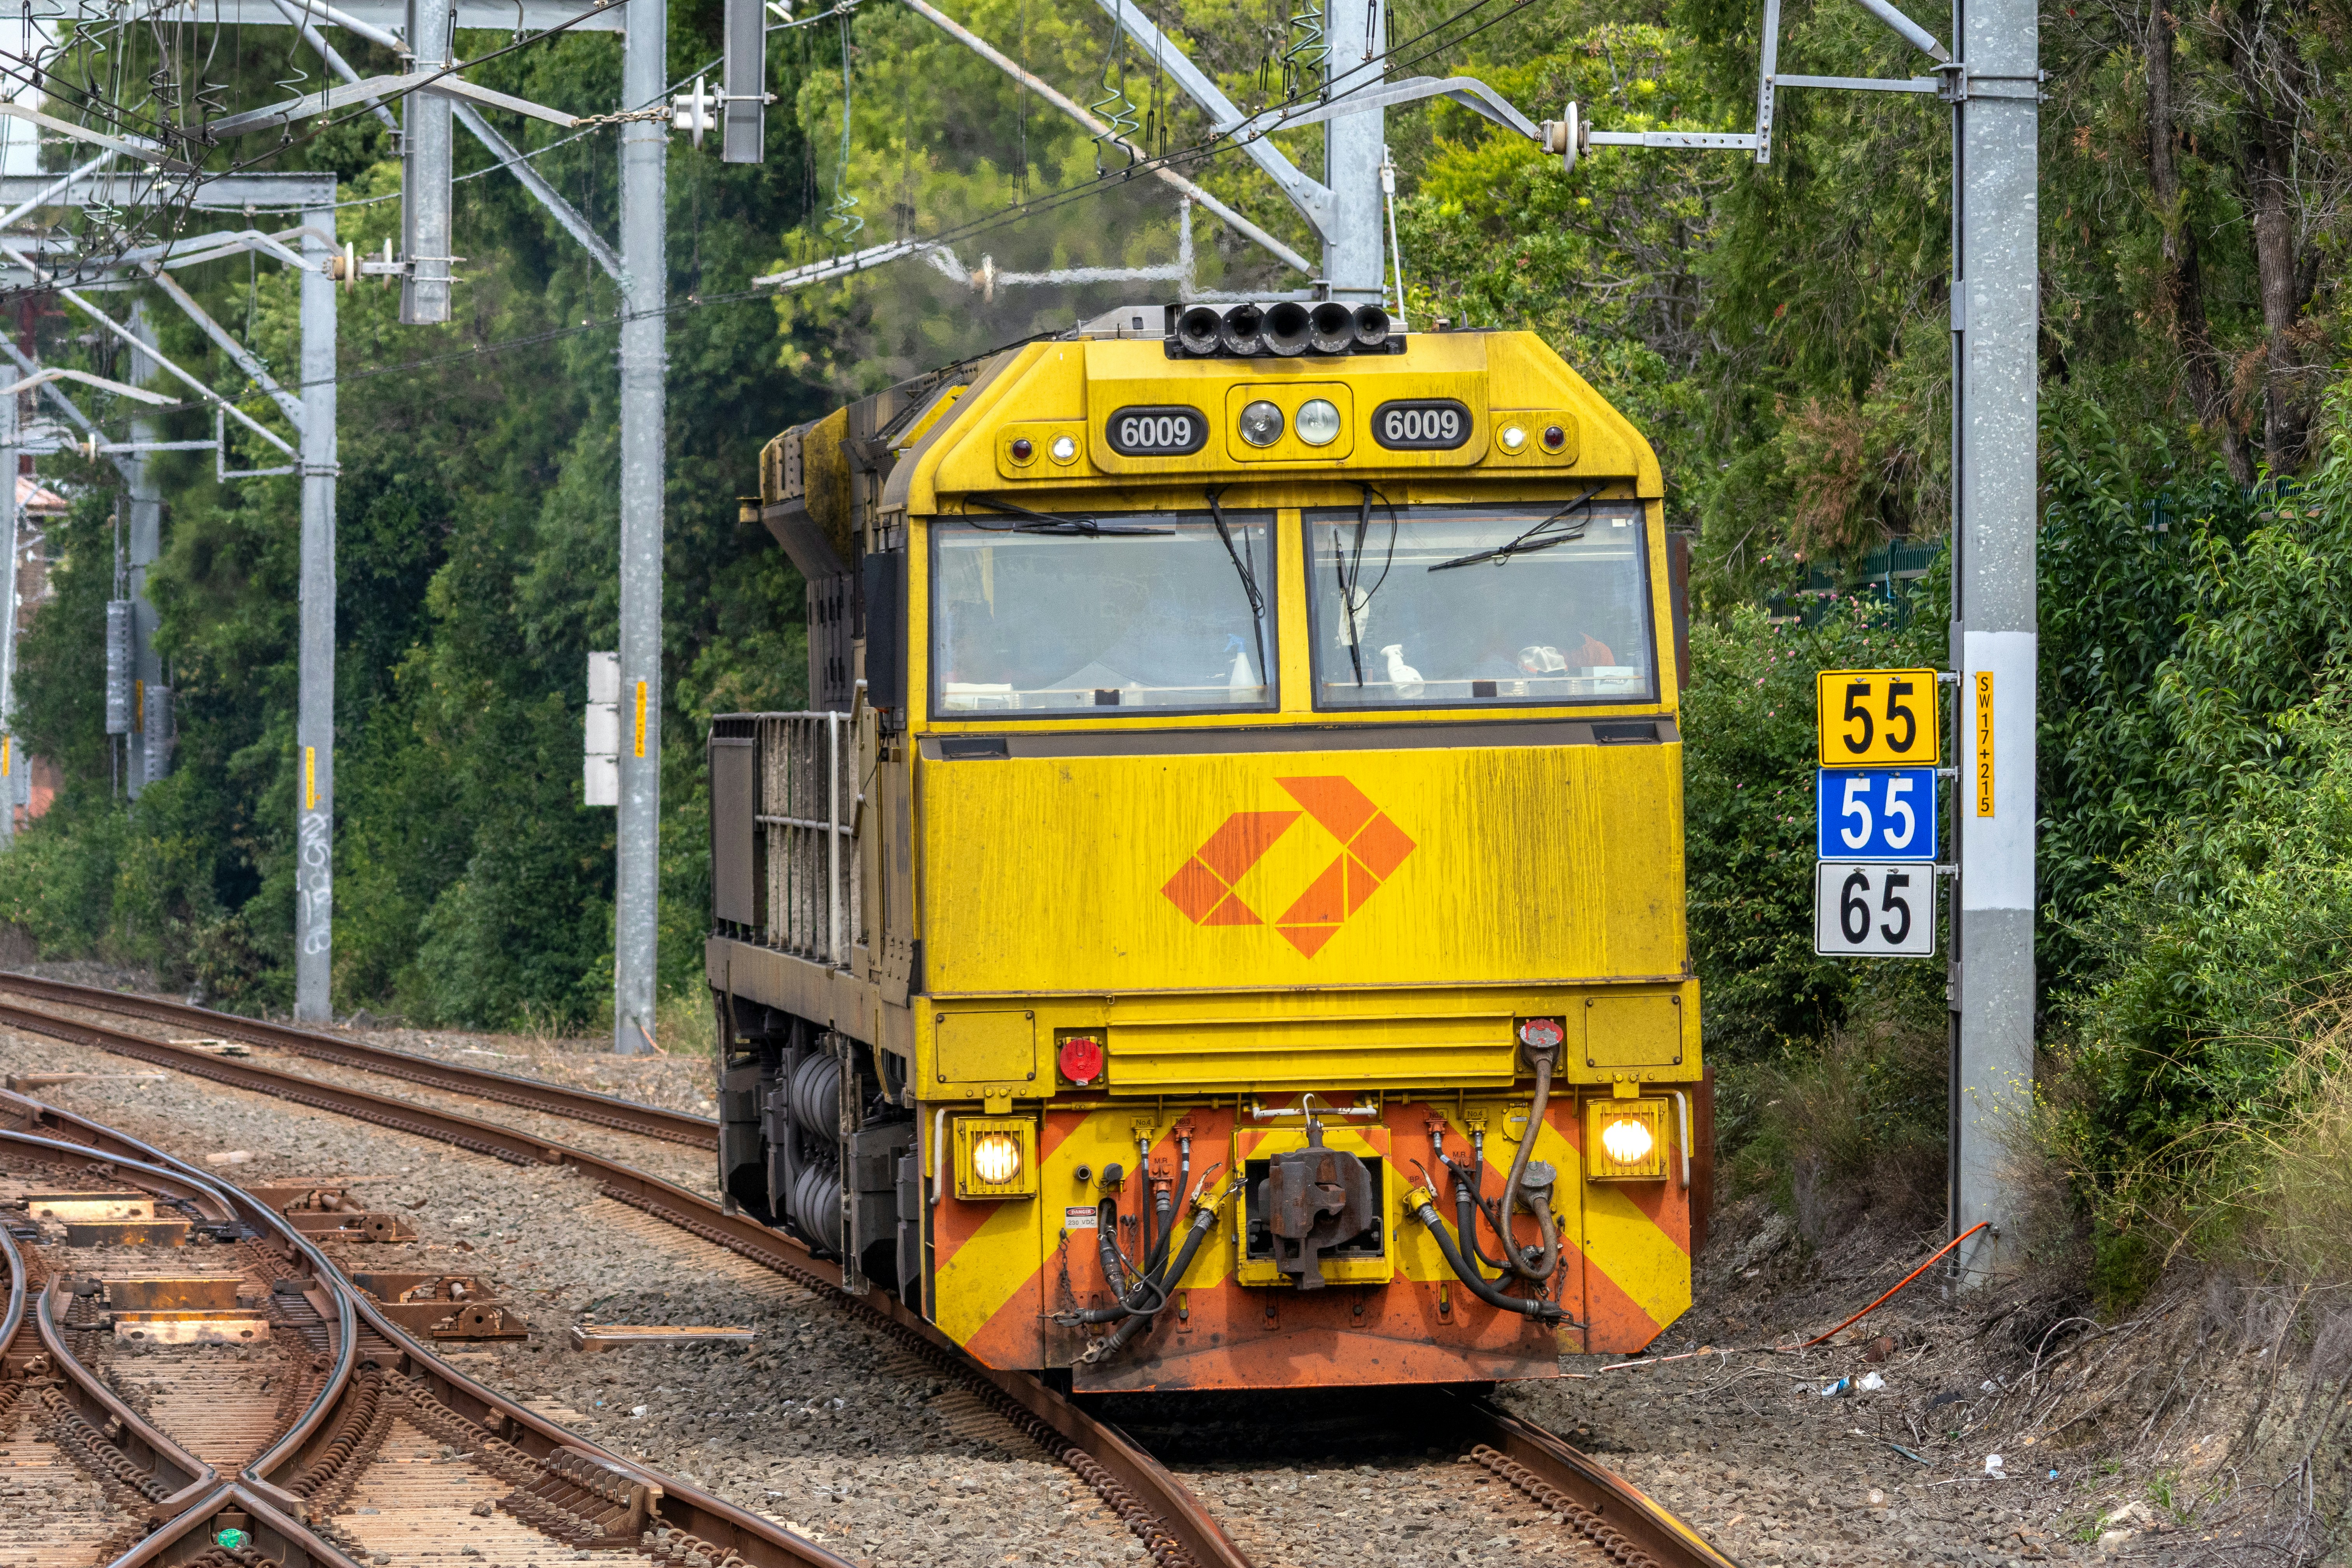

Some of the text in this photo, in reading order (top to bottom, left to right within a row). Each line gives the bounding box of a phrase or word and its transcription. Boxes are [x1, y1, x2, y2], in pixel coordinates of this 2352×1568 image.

[1121, 417, 1191, 447] 6009
[1385, 410, 1459, 440] 6009
[1843, 683, 1916, 754] 55
[1841, 778, 1915, 849] 55
[1840, 873, 1910, 945] 65
